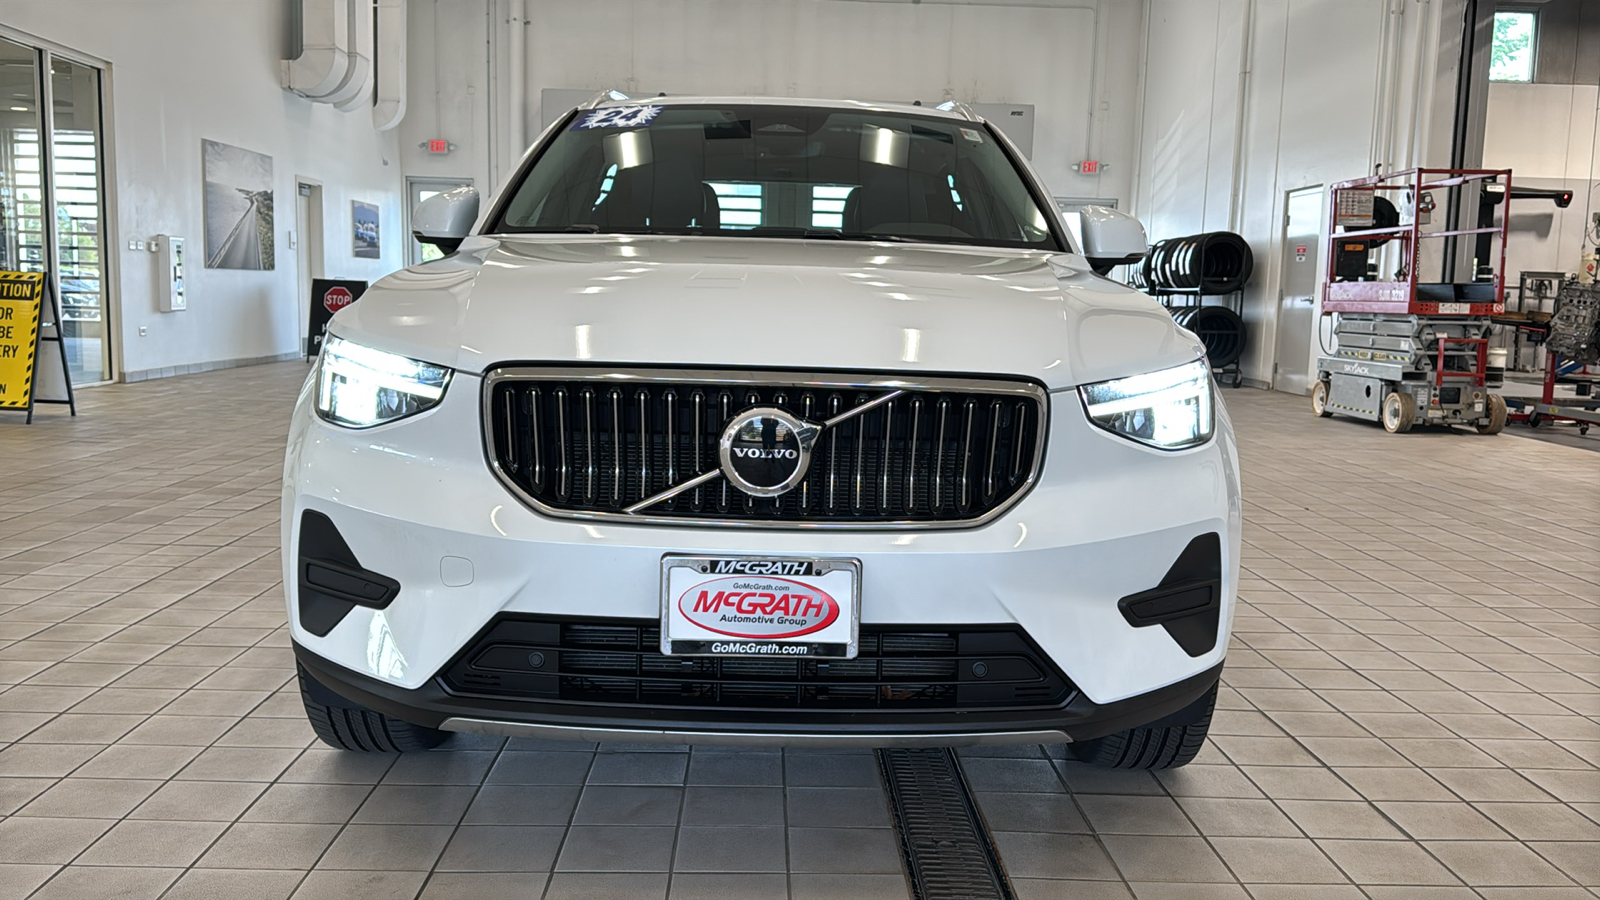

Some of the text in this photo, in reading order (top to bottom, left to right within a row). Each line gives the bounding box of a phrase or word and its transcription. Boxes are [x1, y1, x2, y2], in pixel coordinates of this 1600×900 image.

[594, 109, 644, 124] 24
[1082, 161, 1097, 173] EXIT
[0, 283, 32, 297] TION
[326, 294, 350, 305] STOP
[1343, 363, 1369, 375] SKYJACK
[733, 447, 798, 459] VOLVO
[732, 582, 790, 592] GoMcGrath.com
[719, 614, 808, 627] Automotive Group
[711, 641, 808, 655] GoMcGrath.com
